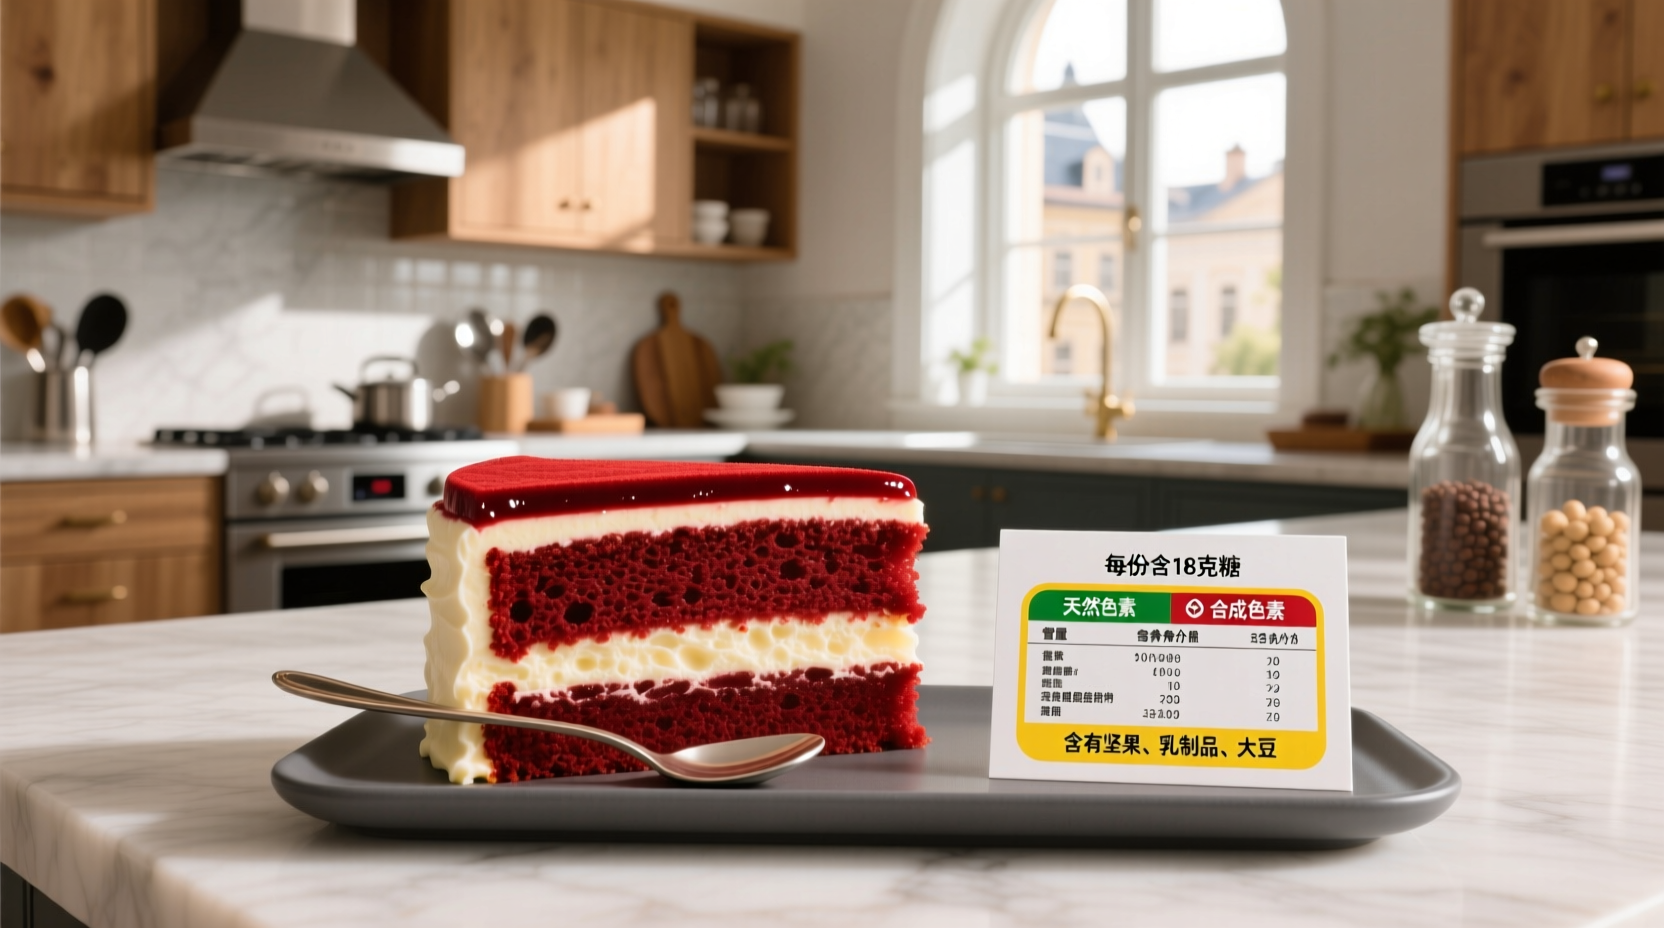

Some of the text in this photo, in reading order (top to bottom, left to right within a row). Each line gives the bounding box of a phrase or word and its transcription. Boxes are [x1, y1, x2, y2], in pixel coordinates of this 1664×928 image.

[1105, 553, 1241, 578] 每份含18克糖
[1063, 596, 1136, 618] 天然色素
[1210, 599, 1285, 621] 合成色素
[1064, 731, 1277, 760] 含有坚果、乳制品、大豆
